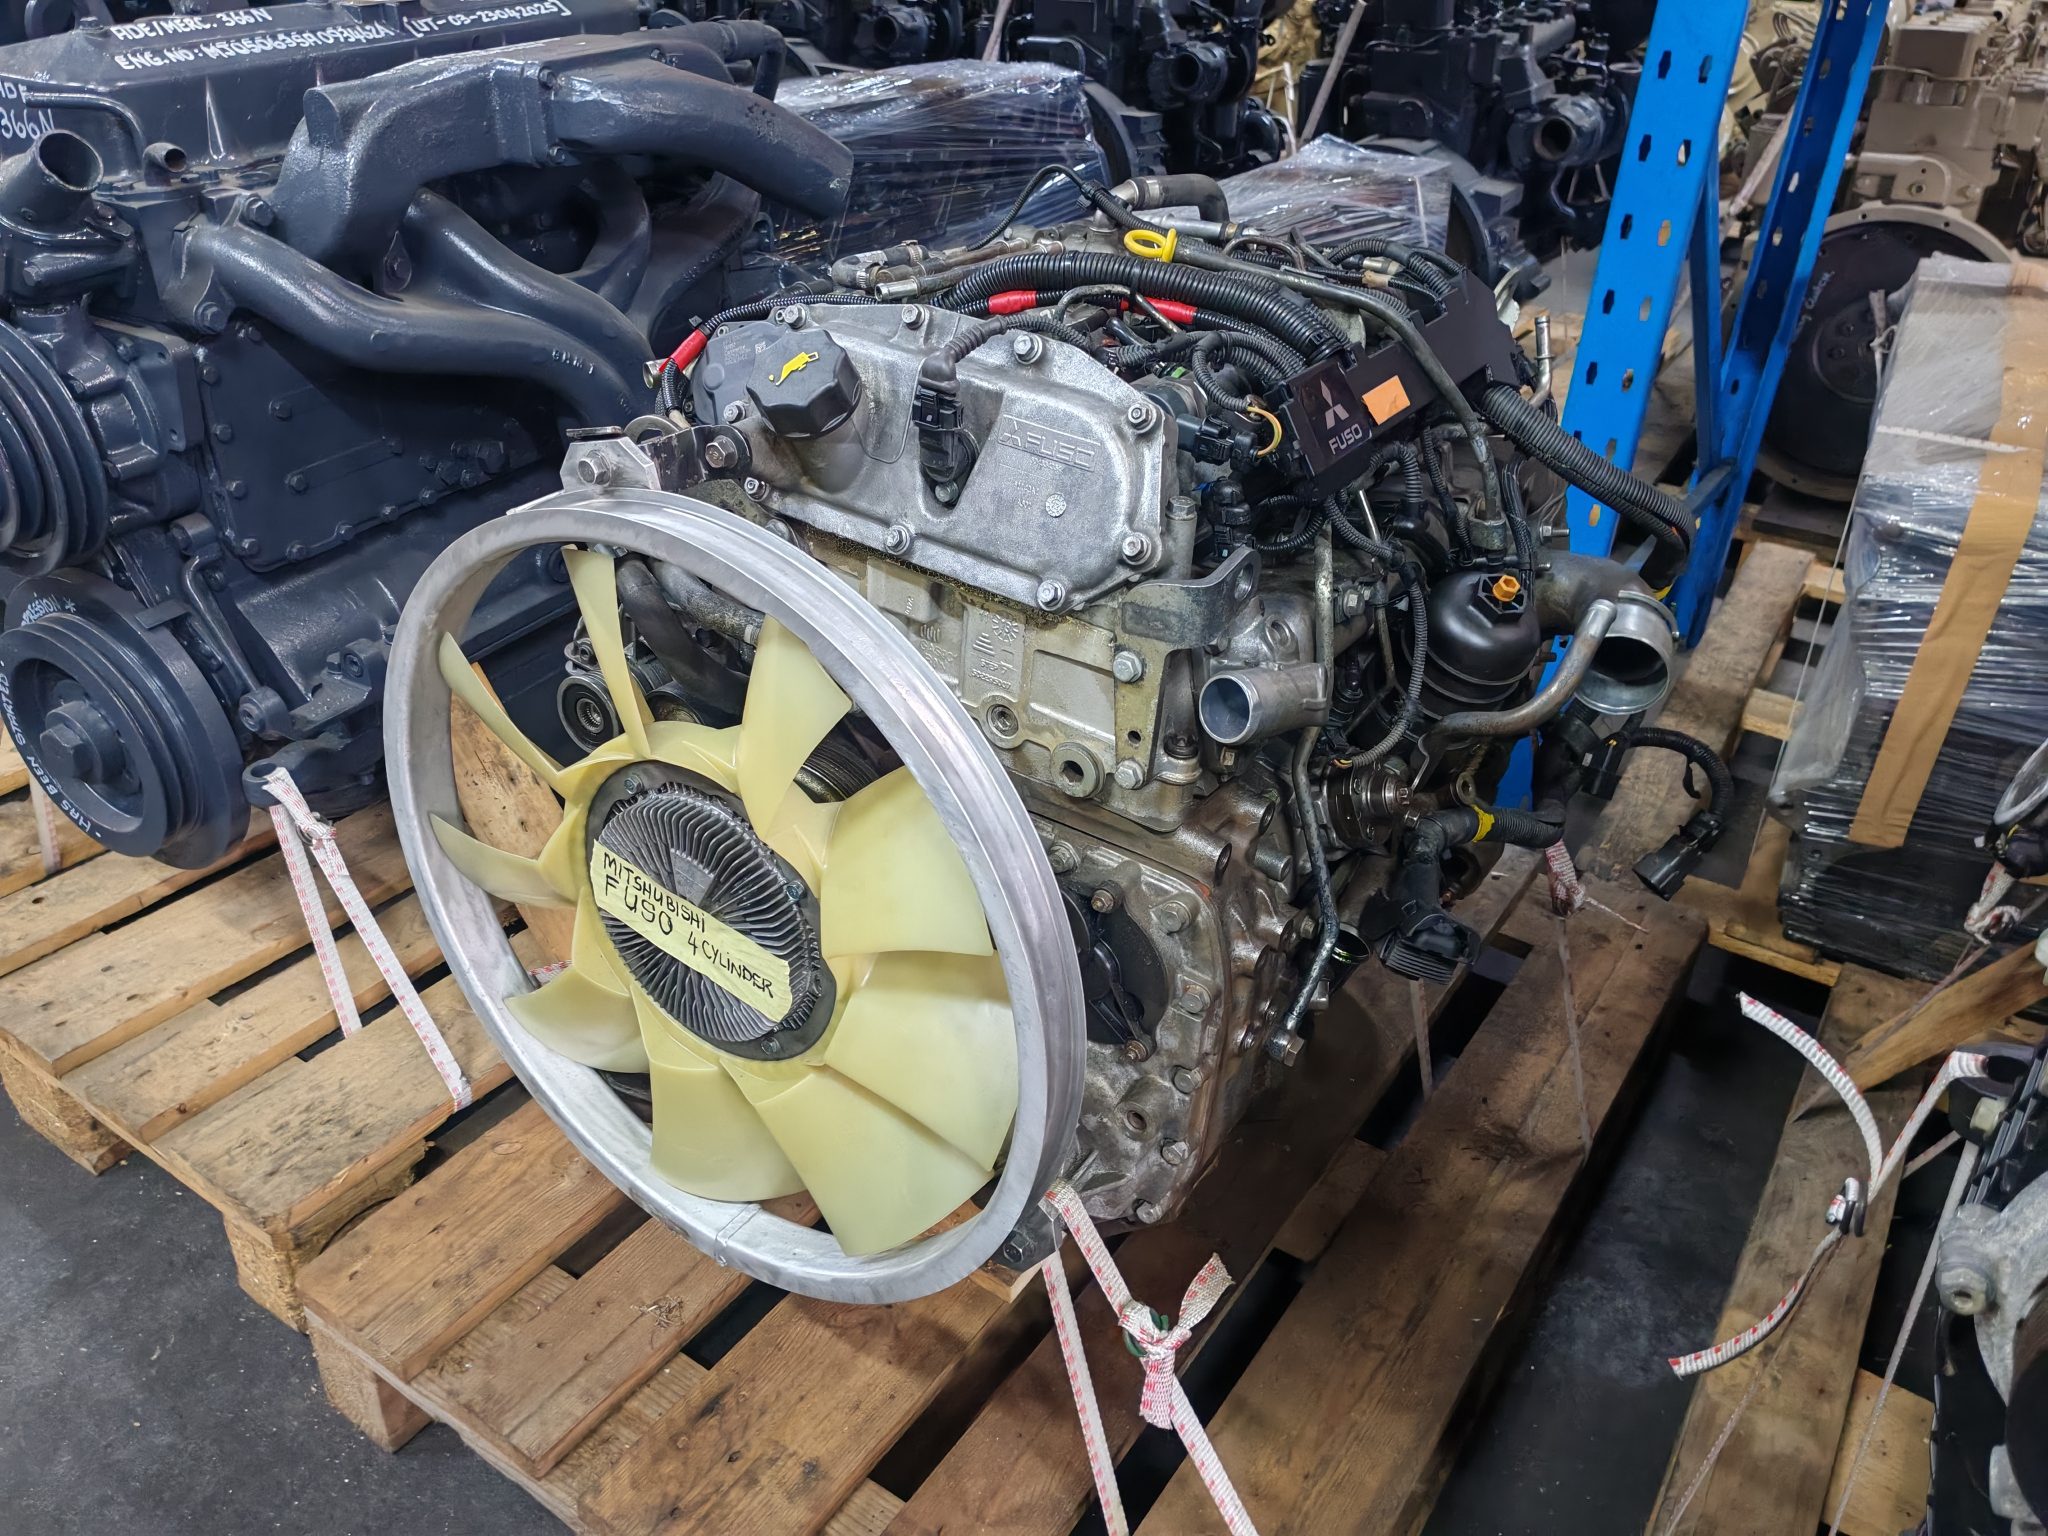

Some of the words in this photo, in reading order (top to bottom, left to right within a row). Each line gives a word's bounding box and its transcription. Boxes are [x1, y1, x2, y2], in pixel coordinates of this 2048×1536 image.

[110, 17, 218, 41] ADE/MERC.
[217, 8, 273, 28] 366N
[0, 107, 55, 140] 366N
[1328, 423, 1363, 455] FUSO
[27, 756, 58, 795] BEEN
[604, 873, 674, 936] FUSO
